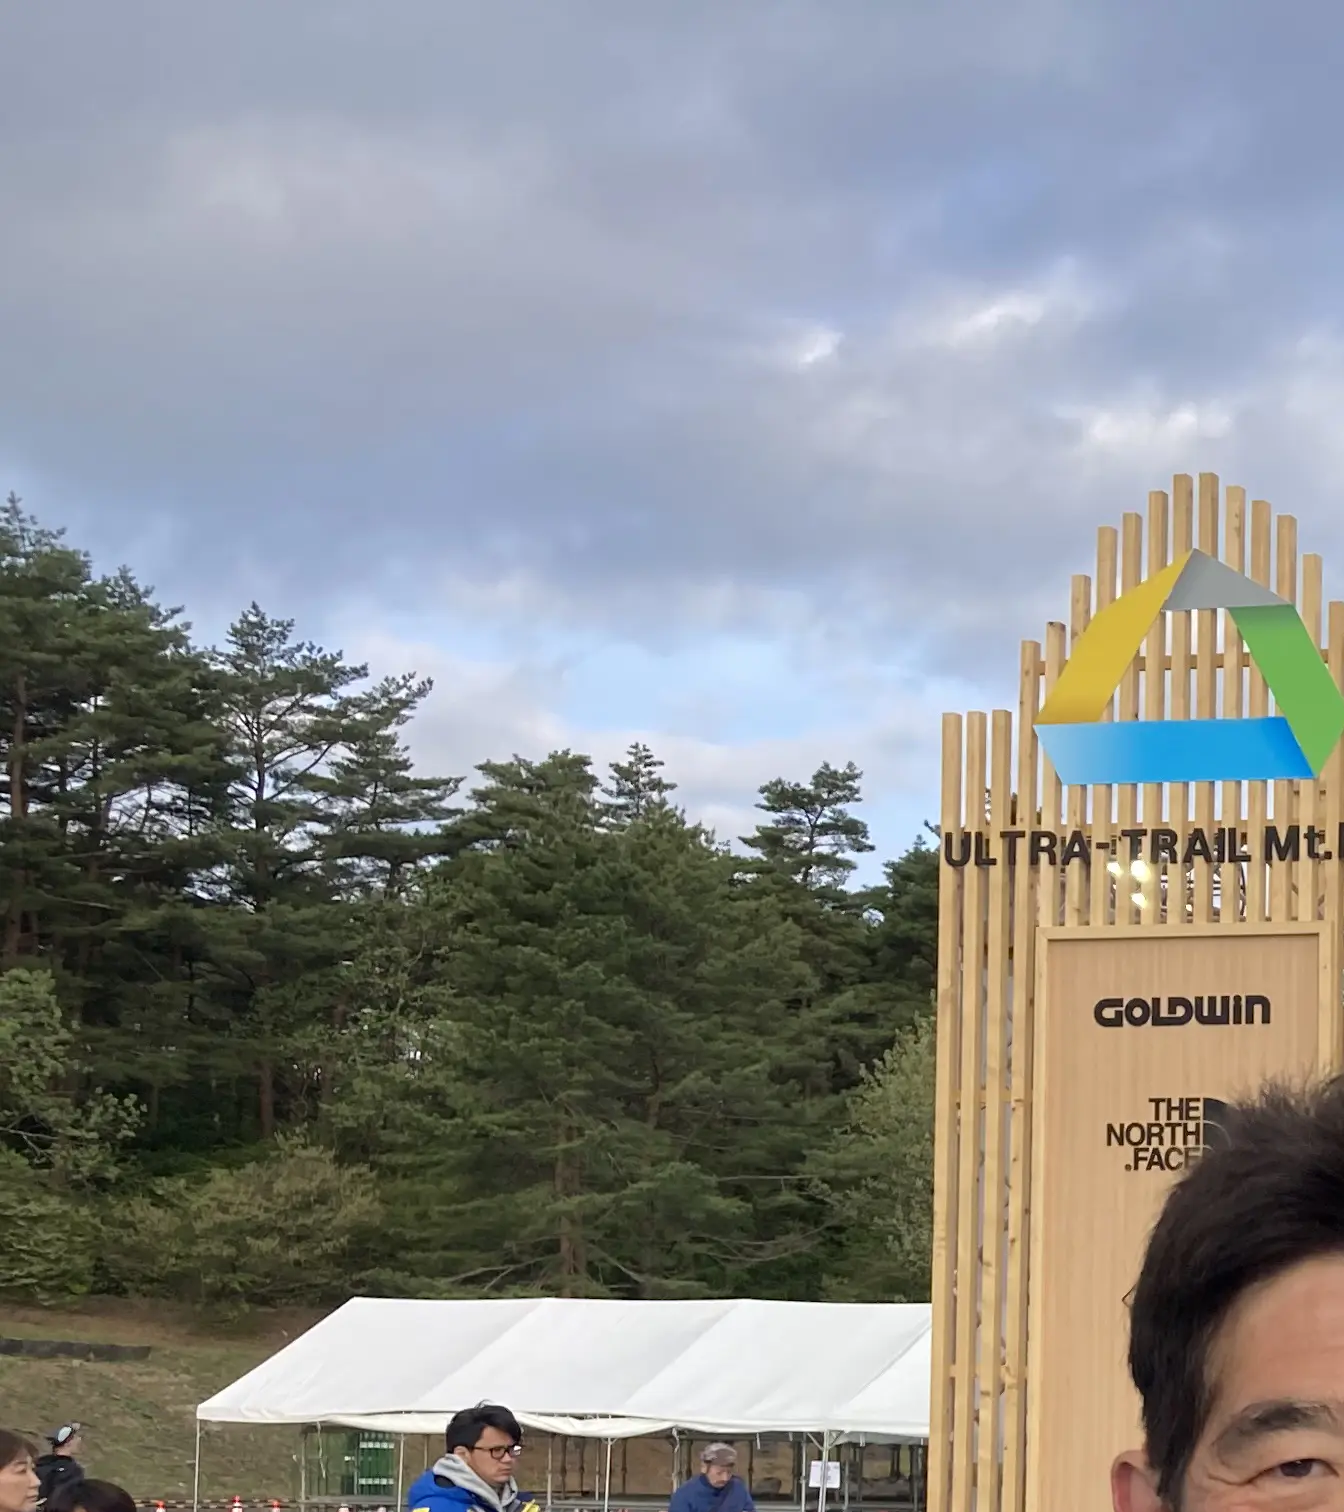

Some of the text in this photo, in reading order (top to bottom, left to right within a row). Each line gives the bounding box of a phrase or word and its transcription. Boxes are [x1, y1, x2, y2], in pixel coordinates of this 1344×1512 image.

[944, 827, 1251, 867] ULTRA-TRAIL
[1149, 1098, 1200, 1121] THE
[1107, 1122, 1200, 1147] NORTH
